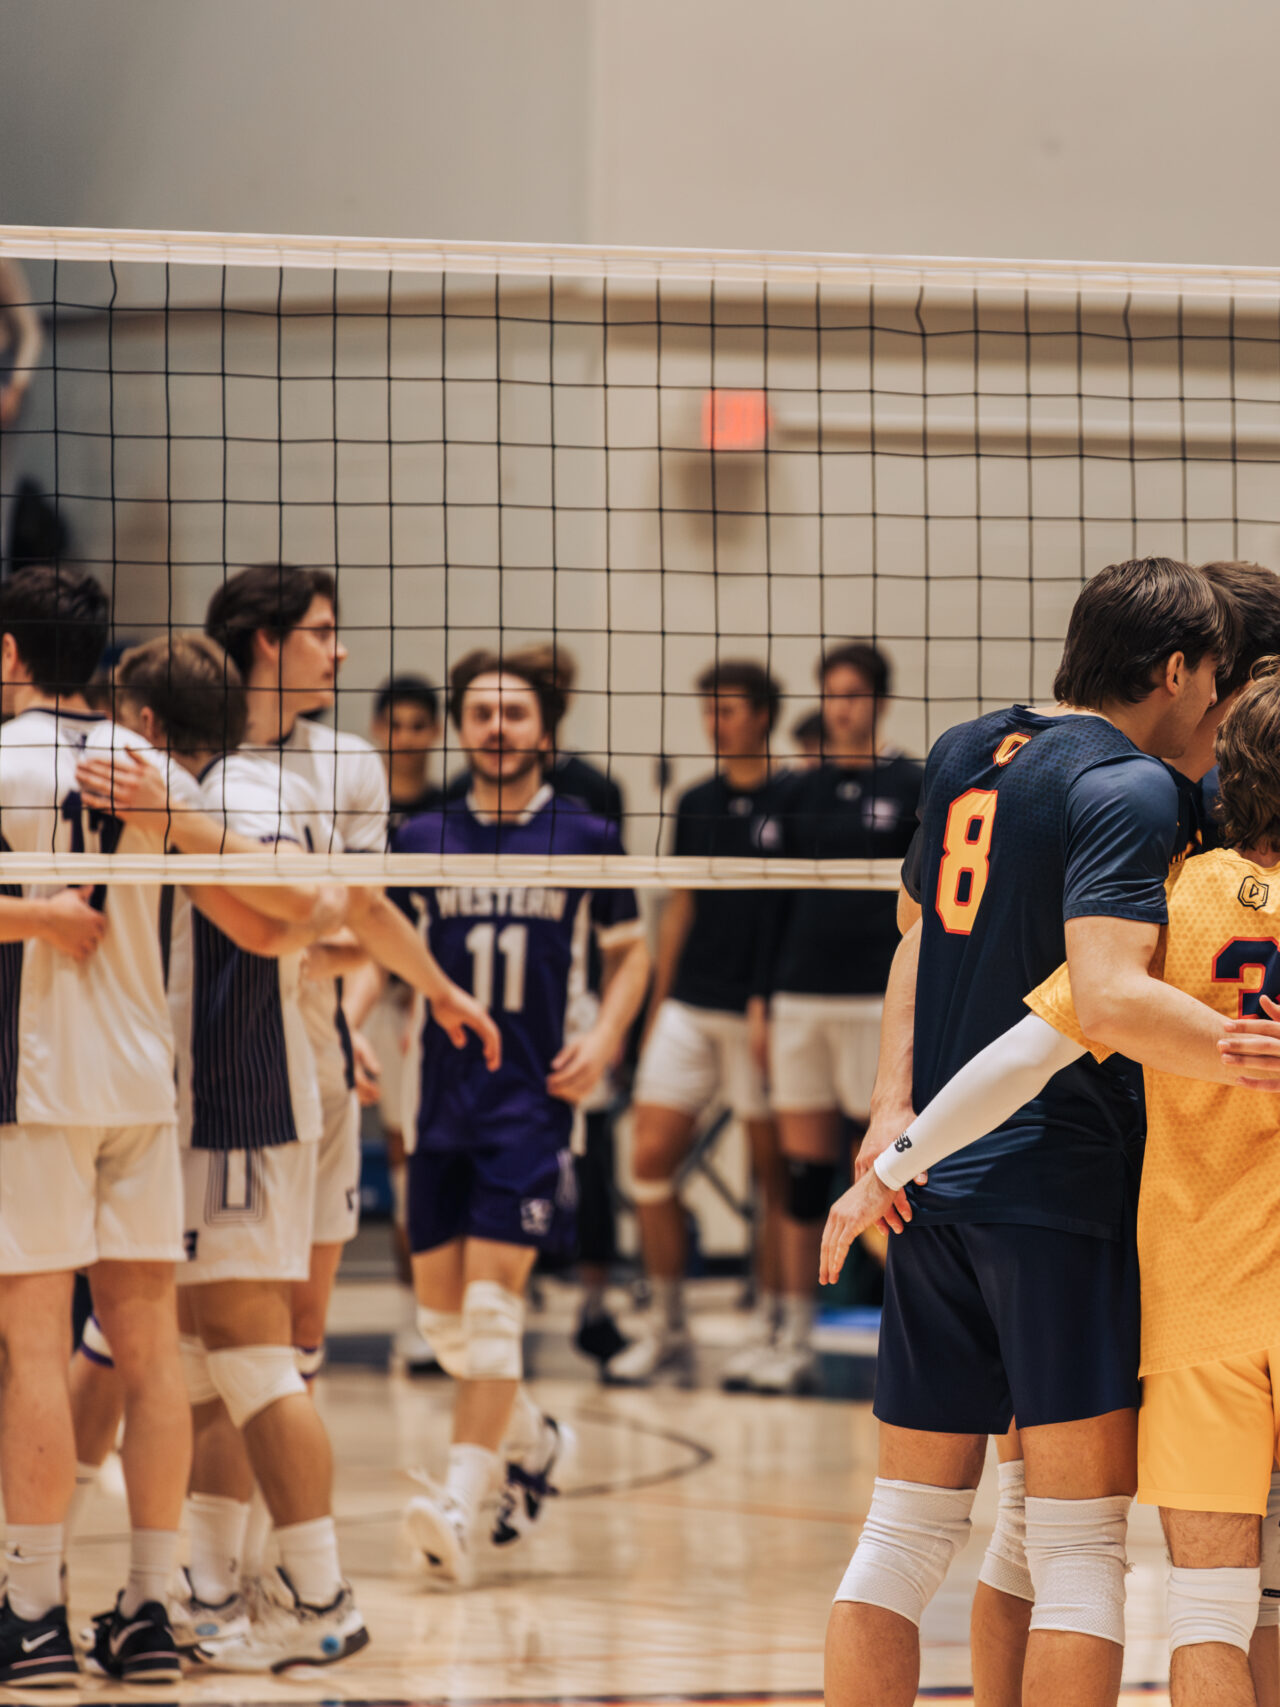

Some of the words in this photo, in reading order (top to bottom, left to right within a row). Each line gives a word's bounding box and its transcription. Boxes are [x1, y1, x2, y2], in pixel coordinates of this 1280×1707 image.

[435, 886, 568, 922] WESTERN
[935, 787, 998, 935] 8
[465, 922, 528, 1013] 11
